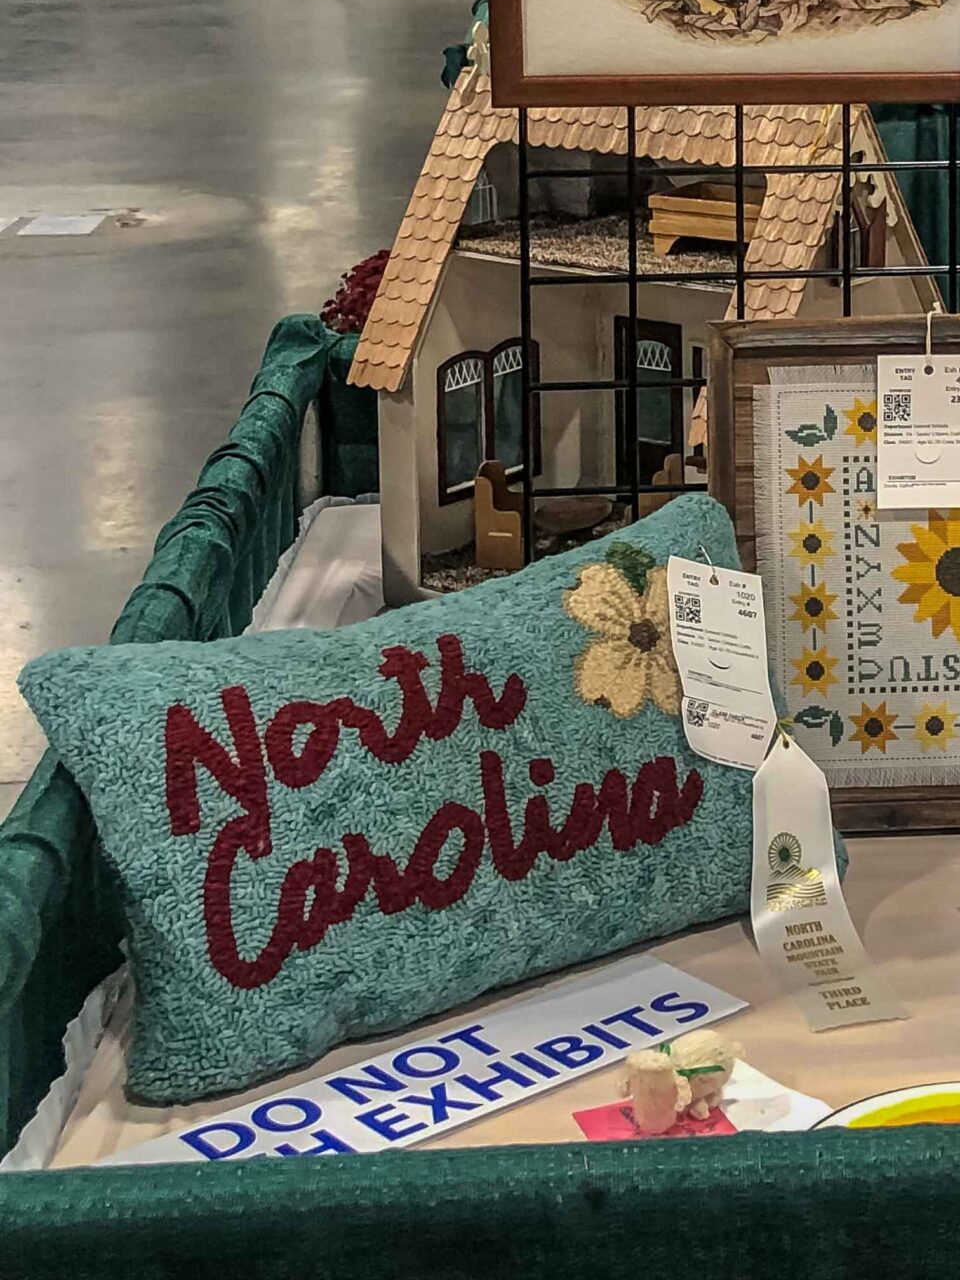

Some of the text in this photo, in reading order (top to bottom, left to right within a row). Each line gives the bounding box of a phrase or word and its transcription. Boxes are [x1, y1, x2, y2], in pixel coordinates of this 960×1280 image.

[854, 467, 876, 493] A
[736, 592, 755, 601] 1020
[164, 634, 528, 838] North
[204, 750, 704, 989] Carolina
[785, 921, 823, 936] NORTH
[783, 934, 837, 951] CAROLINA
[786, 946, 844, 962] MOUNTAIN
[803, 958, 838, 969] STATE
[819, 986, 862, 999] THIRD
[826, 997, 871, 1010] PLACE
[353, 991, 710, 1141] EXHIBITS
[179, 1024, 500, 1160] DO NOT
